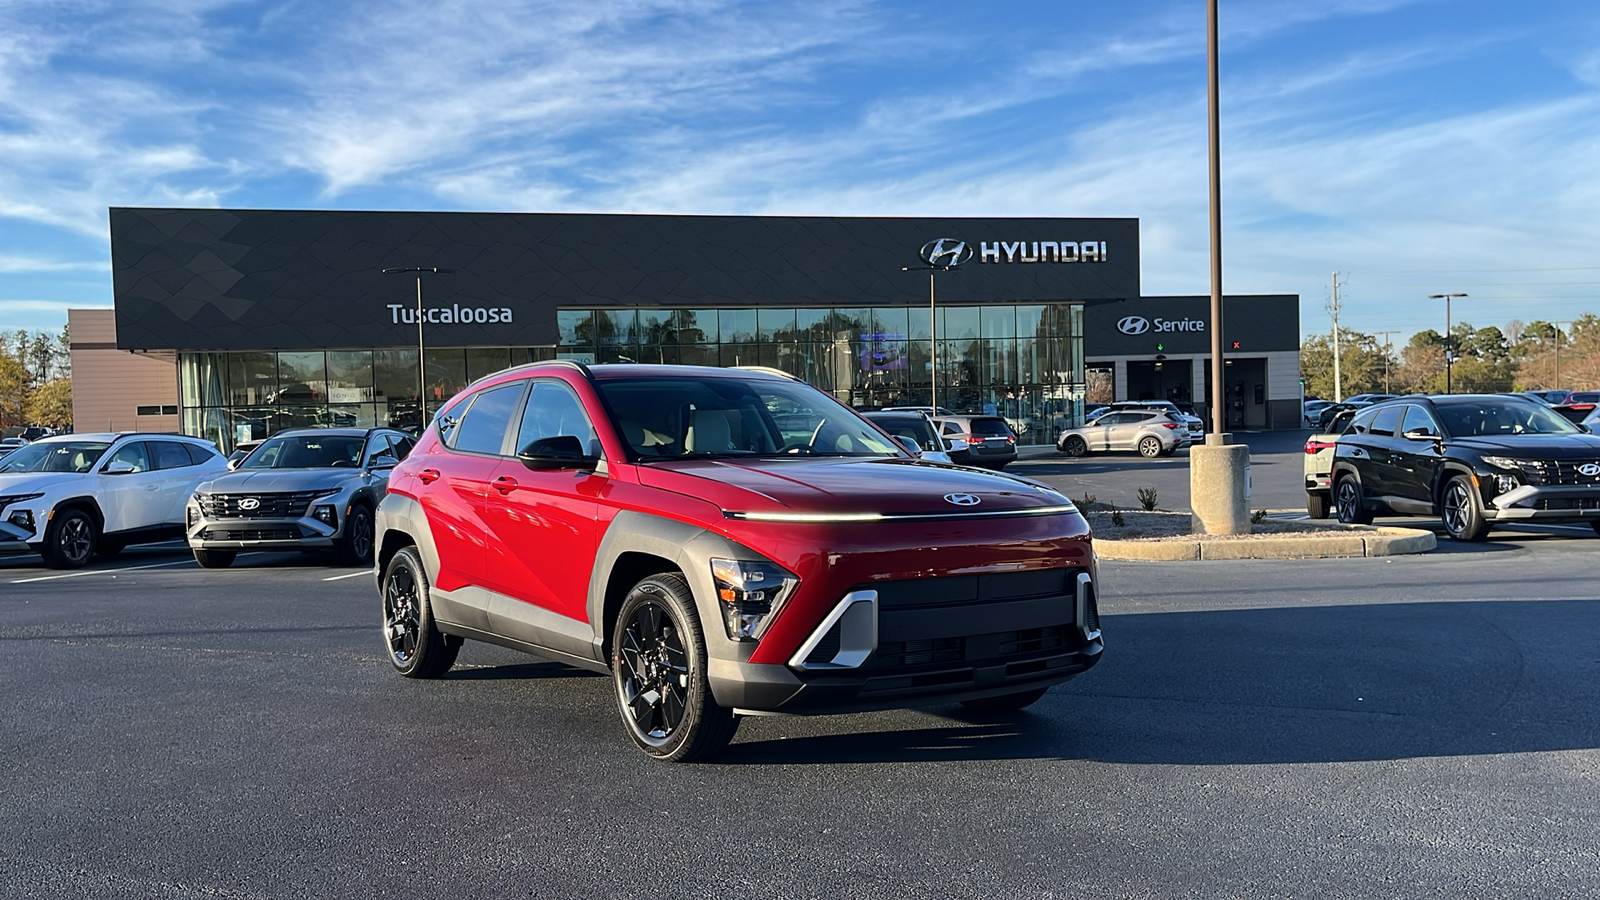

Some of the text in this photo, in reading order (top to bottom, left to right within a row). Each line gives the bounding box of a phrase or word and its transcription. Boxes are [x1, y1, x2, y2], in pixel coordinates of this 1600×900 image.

[980, 241, 1107, 263] HYUNDAI
[386, 303, 513, 324] Tuscaloosa
[1153, 317, 1205, 332] Service
